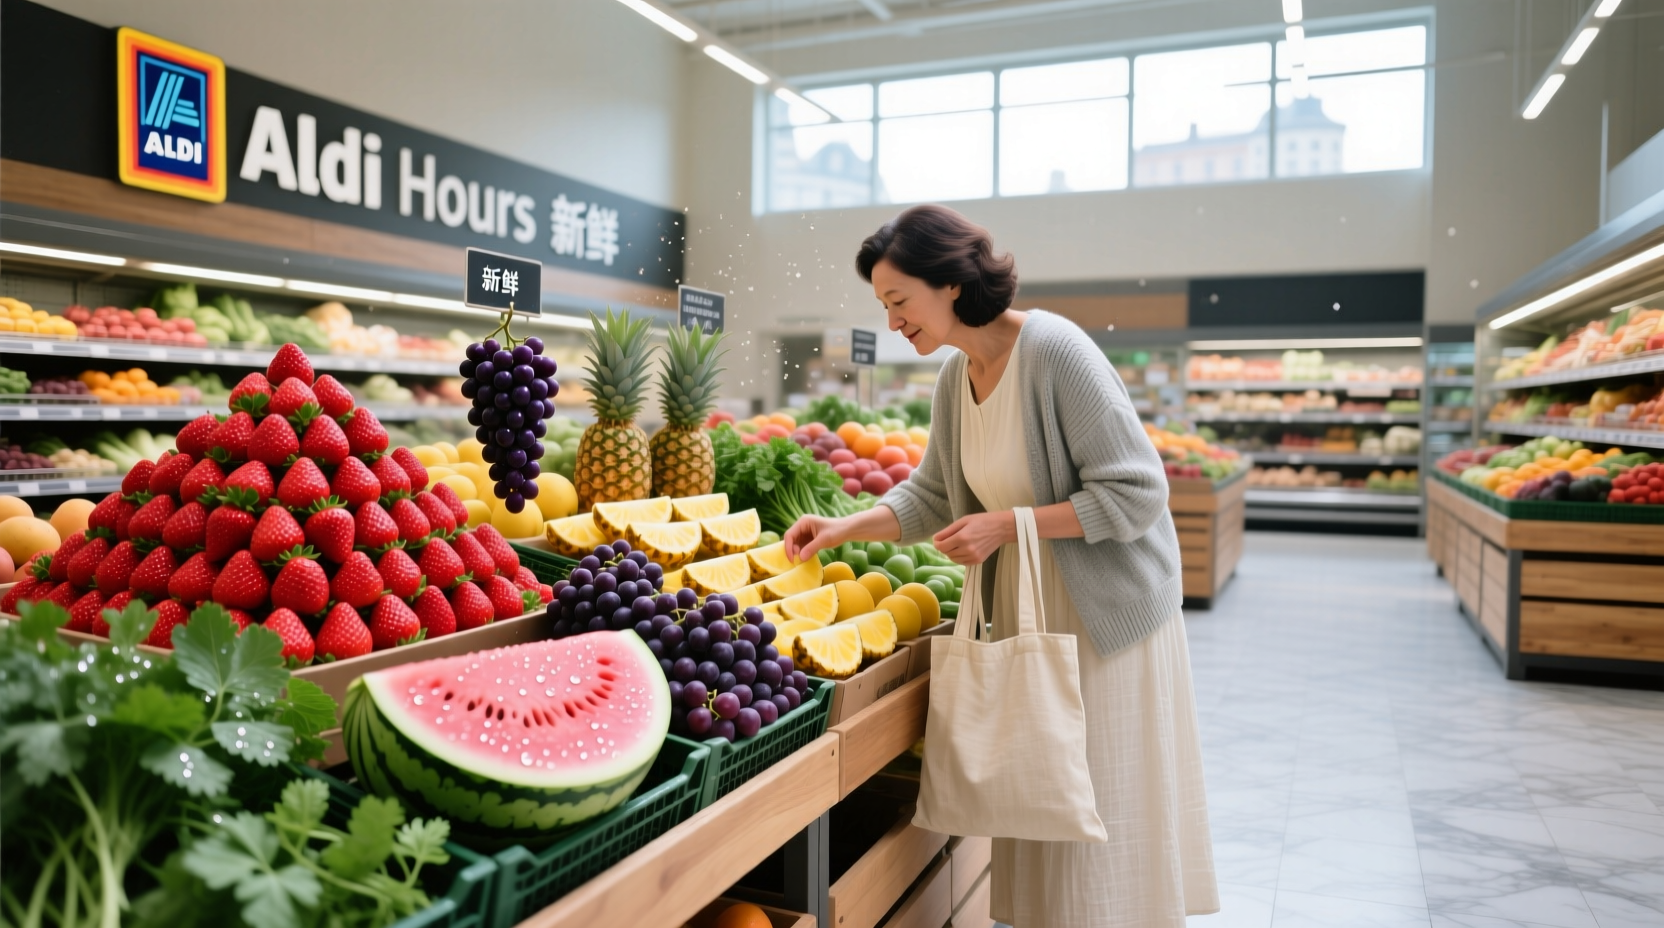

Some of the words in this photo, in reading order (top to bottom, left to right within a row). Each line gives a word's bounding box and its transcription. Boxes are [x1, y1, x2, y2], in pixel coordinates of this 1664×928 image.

[144, 131, 202, 165] ALDI
[240, 105, 382, 210] Aldi
[400, 147, 537, 243] Hours
[550, 193, 620, 266] 新鲜
[481, 264, 519, 297] 新鲜
